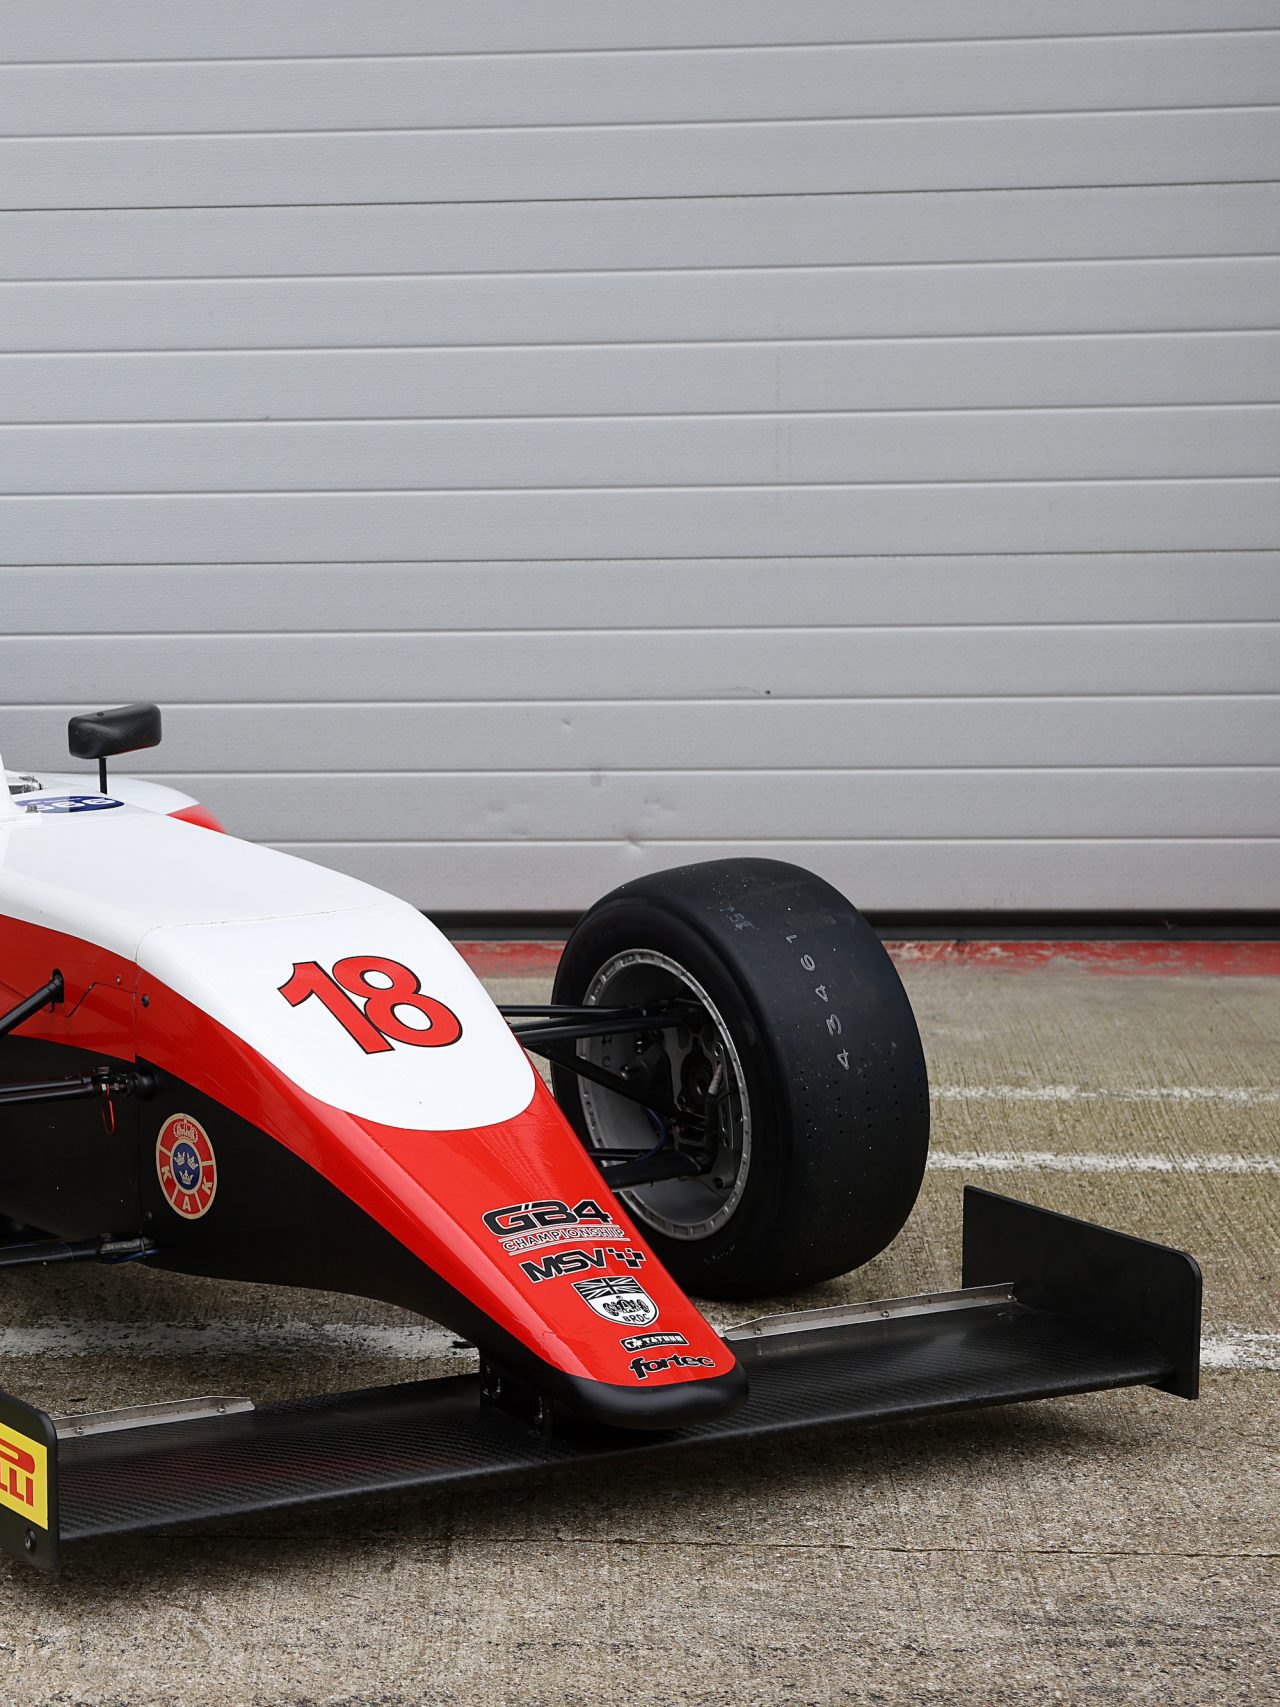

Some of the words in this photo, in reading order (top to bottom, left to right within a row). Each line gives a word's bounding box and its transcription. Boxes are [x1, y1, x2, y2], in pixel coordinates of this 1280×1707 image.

[277, 955, 463, 1055] 18
[482, 1200, 613, 1236] GB4
[503, 1227, 625, 1251] CHAMPIONSHIP
[519, 1248, 606, 1283] MSV
[622, 1313, 651, 1323] BRDC
[628, 1354, 716, 1380] fortec
